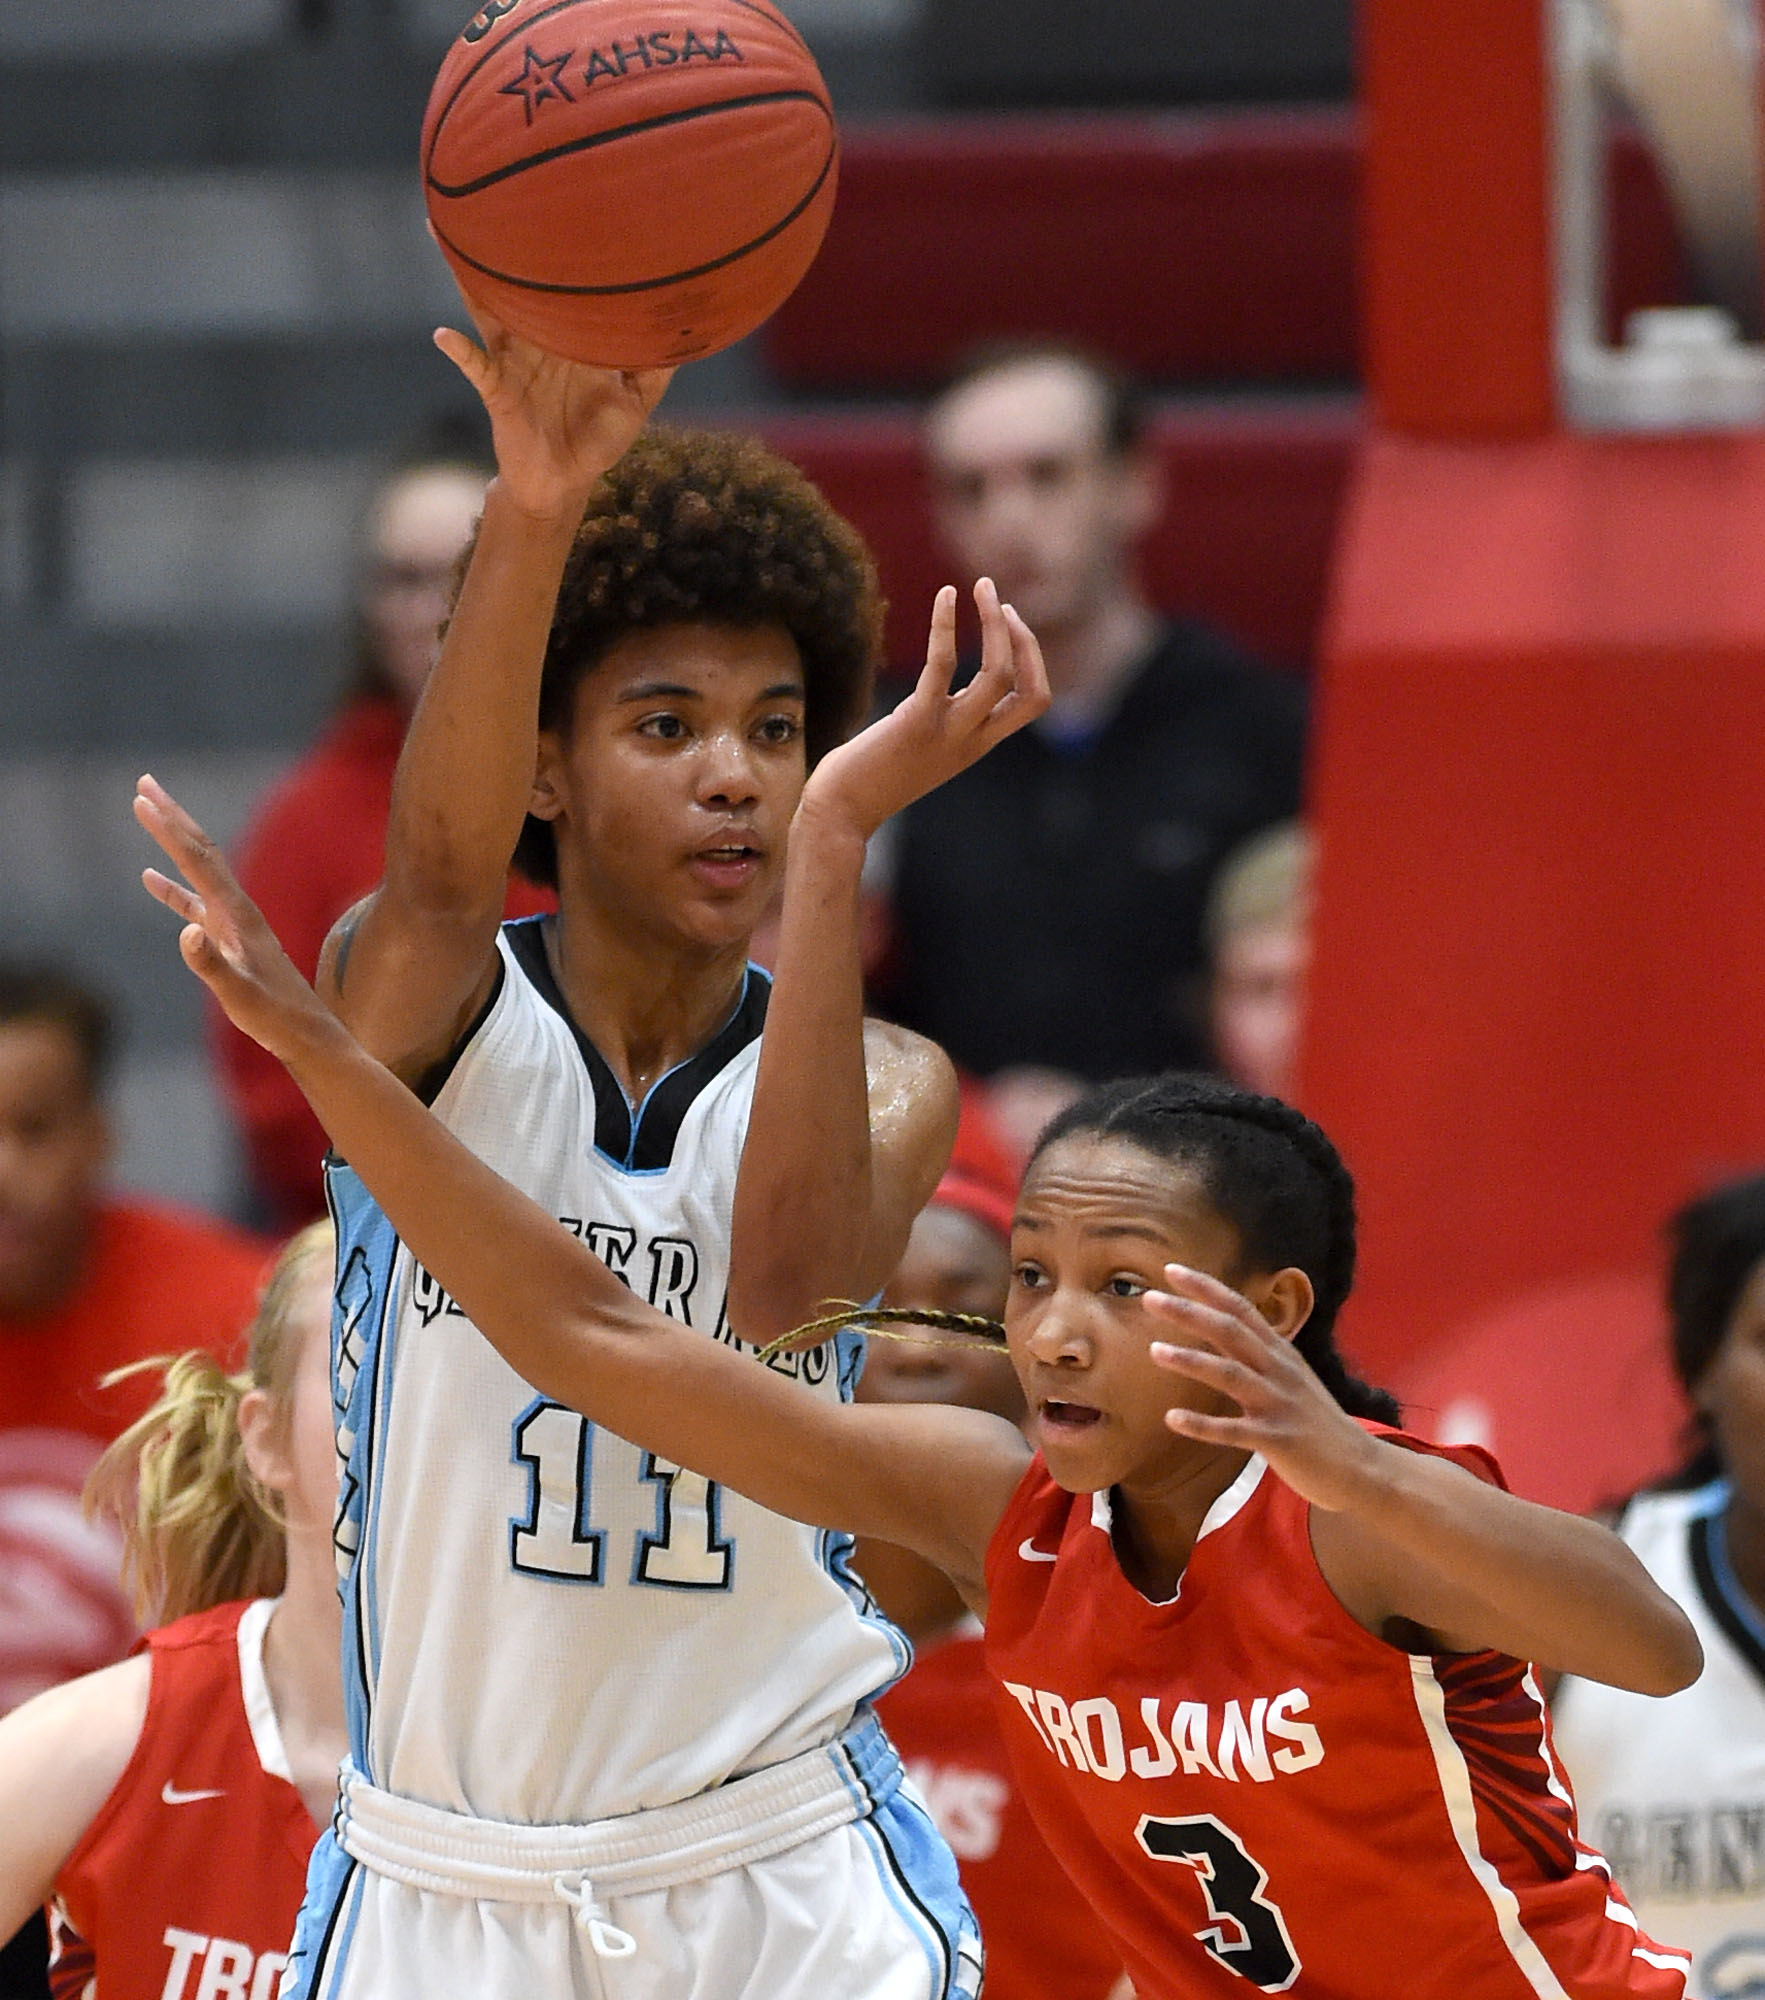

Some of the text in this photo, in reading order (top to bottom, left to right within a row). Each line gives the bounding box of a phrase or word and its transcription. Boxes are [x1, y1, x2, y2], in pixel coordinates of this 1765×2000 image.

[583, 26, 745, 87] AHSAA
[508, 1393, 737, 1593] 11
[1003, 1680, 1326, 1783] TROJANS
[1133, 1812, 1303, 1995] 3
